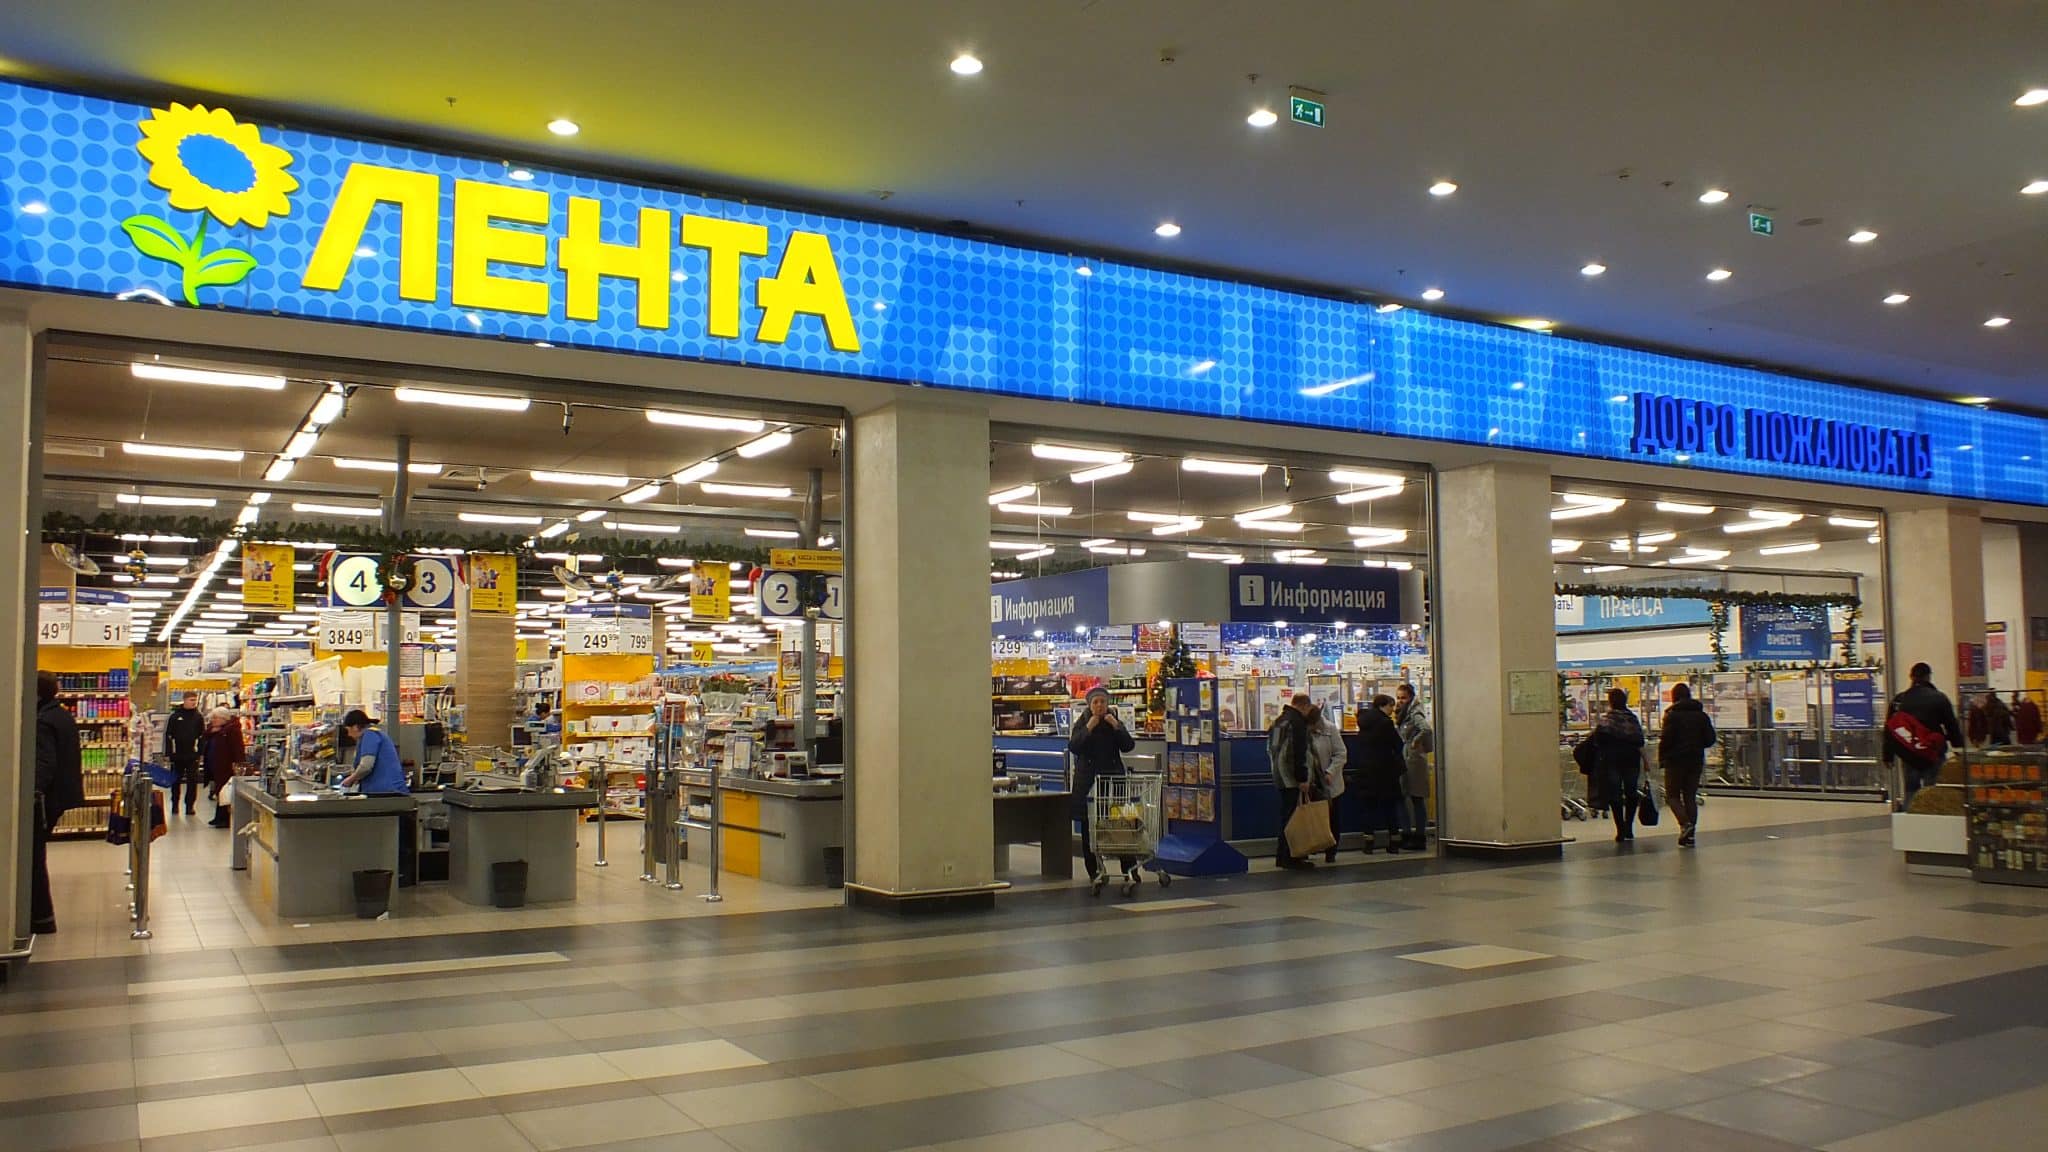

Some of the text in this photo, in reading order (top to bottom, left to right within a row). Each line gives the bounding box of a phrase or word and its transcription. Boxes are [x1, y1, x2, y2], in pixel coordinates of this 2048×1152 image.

[301, 162, 861, 353] ЛЕНТА
[1630, 392, 1738, 457] ДОБРО
[349, 570, 367, 592] 4
[420, 571, 436, 594] 3
[775, 583, 789, 604] 2
[831, 587, 839, 608] 1
[1270, 581, 1386, 614] Информация
[1005, 596, 1075, 626] Информация
[1600, 595, 1664, 619] ПРЕССА
[41, 623, 59, 639] 49
[103, 624, 121, 641] 51
[328, 630, 362, 645] 3849
[583, 634, 608, 649] 249
[630, 634, 647, 649] 799
[1766, 633, 1803, 646] ВМЕСТЕ
